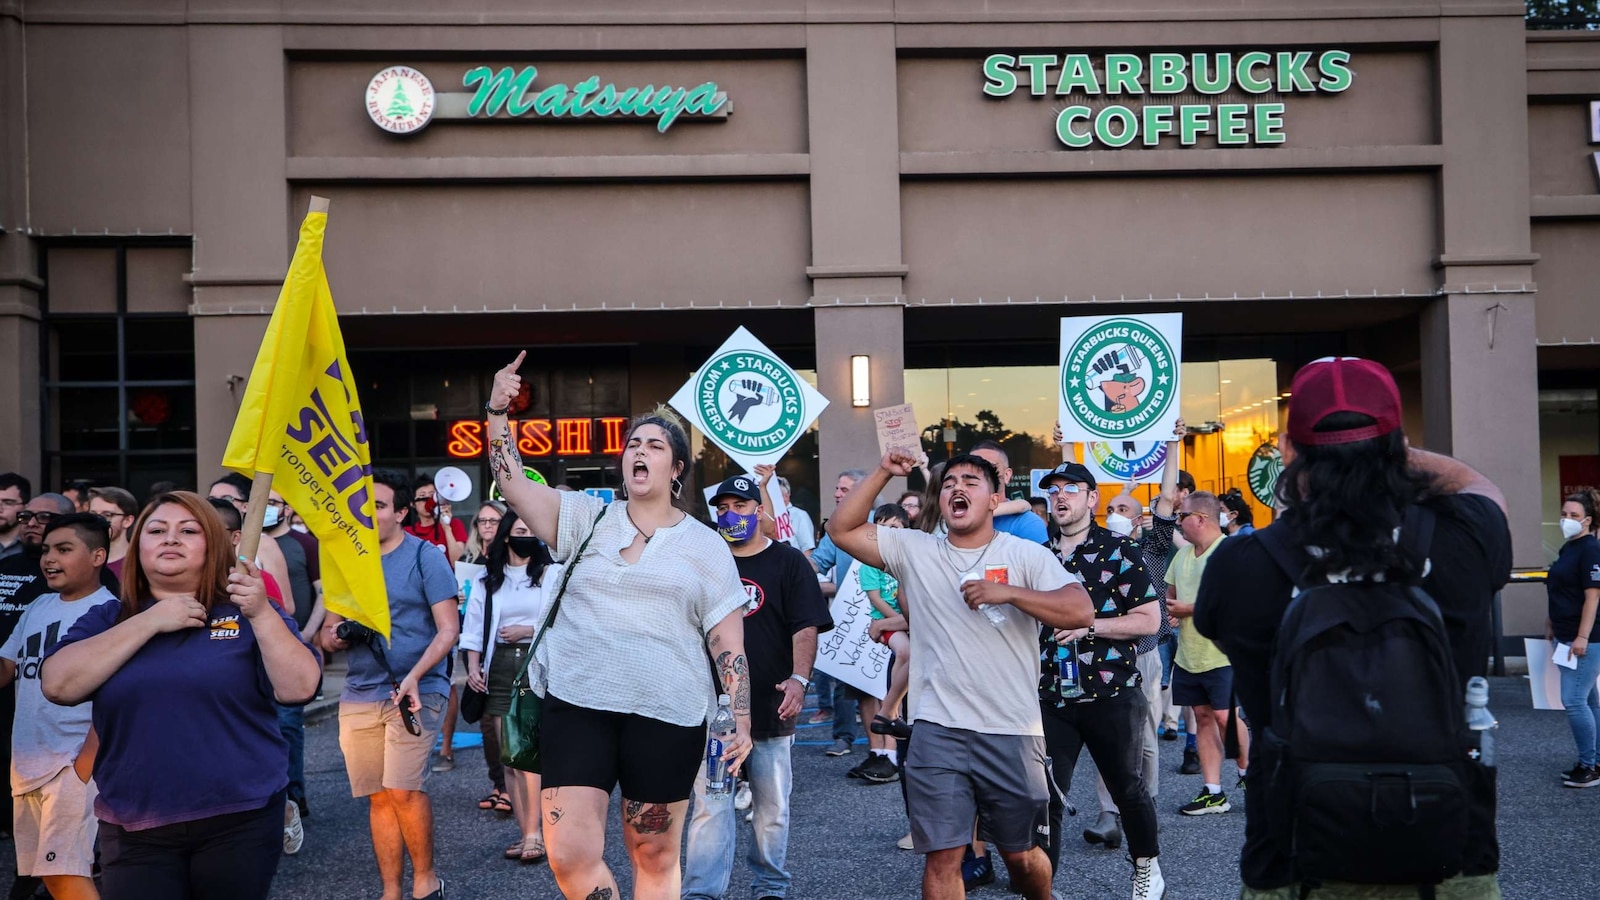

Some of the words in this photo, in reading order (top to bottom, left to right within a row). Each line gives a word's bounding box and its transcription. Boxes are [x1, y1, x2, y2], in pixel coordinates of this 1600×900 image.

[370, 69, 431, 96] JAPANESE
[982, 49, 1353, 96] STARBUCKS
[369, 101, 431, 130] RESTAURANT
[463, 65, 728, 133] Matsuya
[1056, 102, 1286, 148] COFFEE
[1071, 327, 1129, 373] STARBUCKS
[1130, 329, 1168, 369] QUEENS
[702, 368, 727, 432] WORKERS
[736, 357, 798, 414] STARBUCKS
[1072, 392, 1125, 430] WORKERS
[1125, 389, 1165, 428] UNITED
[448, 417, 624, 457] SSHI
[737, 428, 787, 448] UNITED
[1093, 441, 1129, 473] ORKERS
[1141, 441, 1168, 470] UNIT
[280, 444, 325, 496] ronger
[321, 491, 370, 557] Together
[210, 629, 240, 638] SEIU
[820, 589, 865, 660] Starbucks
[861, 646, 890, 680] Coffe
[1065, 661, 1073, 679] smart
[710, 739, 718, 756] water
